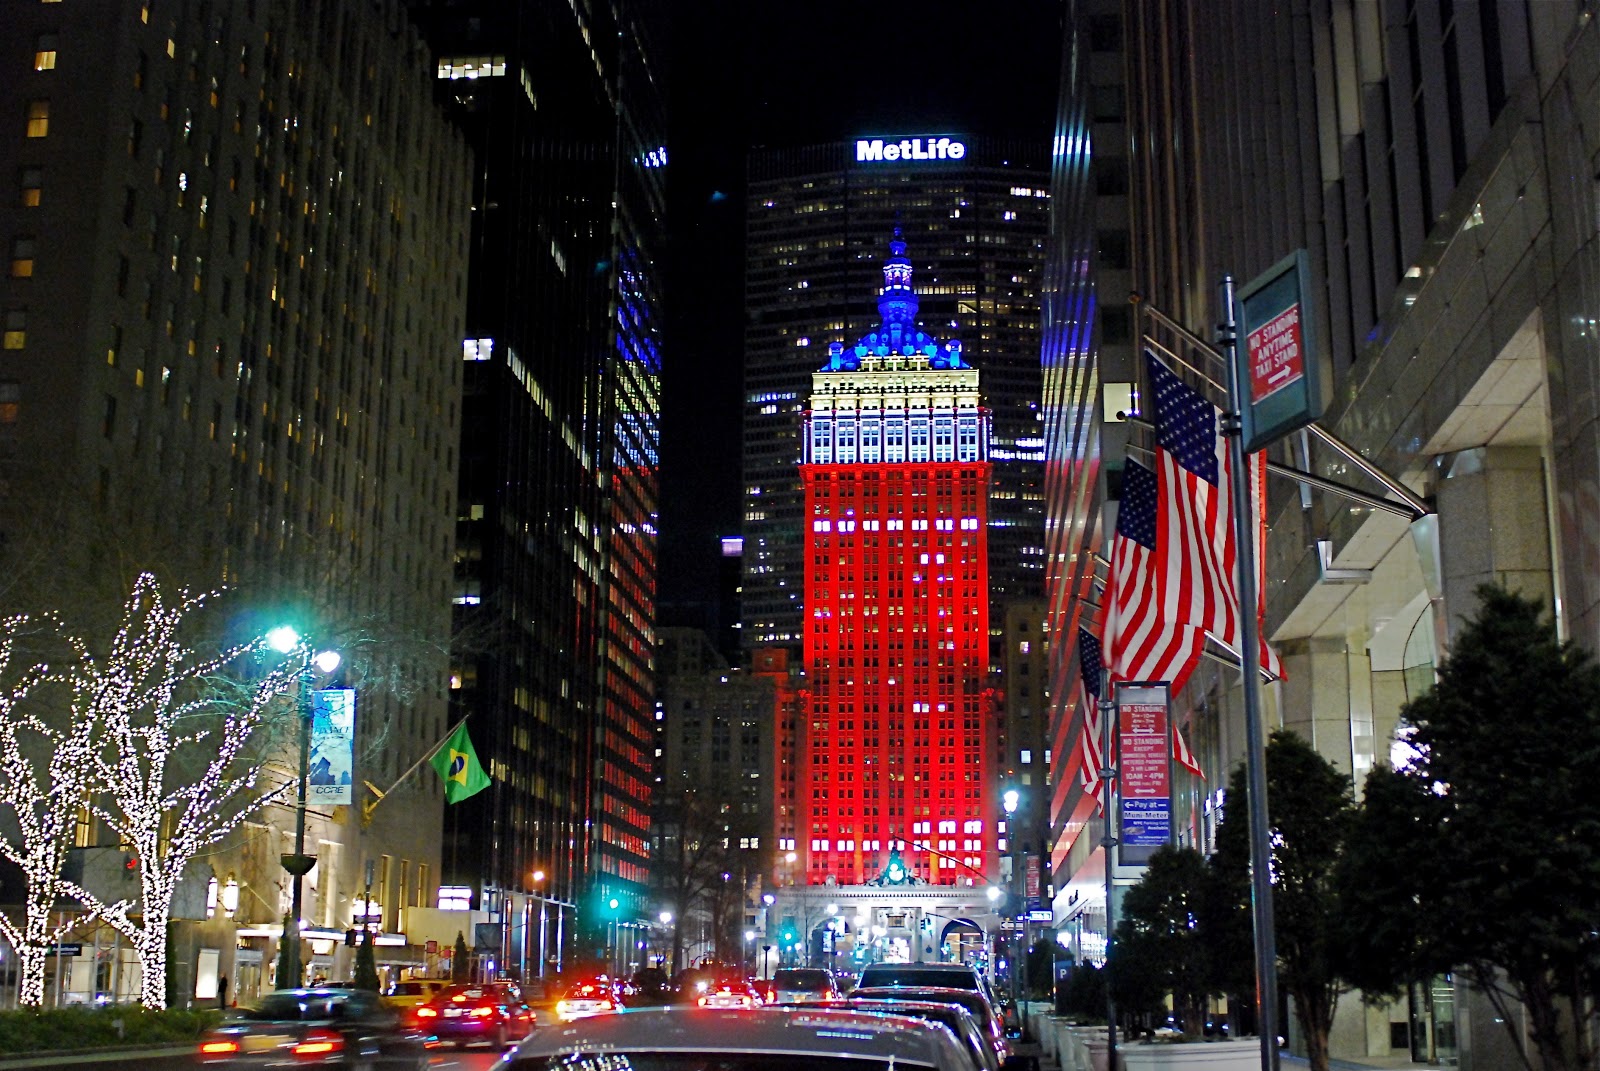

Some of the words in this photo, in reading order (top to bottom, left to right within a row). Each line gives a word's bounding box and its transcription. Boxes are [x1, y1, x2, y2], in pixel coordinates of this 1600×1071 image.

[857, 138, 965, 161] MetLife
[1250, 334, 1261, 351] NO
[1263, 309, 1299, 343] STANDING
[1257, 329, 1295, 363] ANYTIME
[1255, 358, 1272, 379] TAXI
[1274, 343, 1298, 368] STAND
[1134, 801, 1148, 809] Pay
[1060, 969, 1066, 978] P
